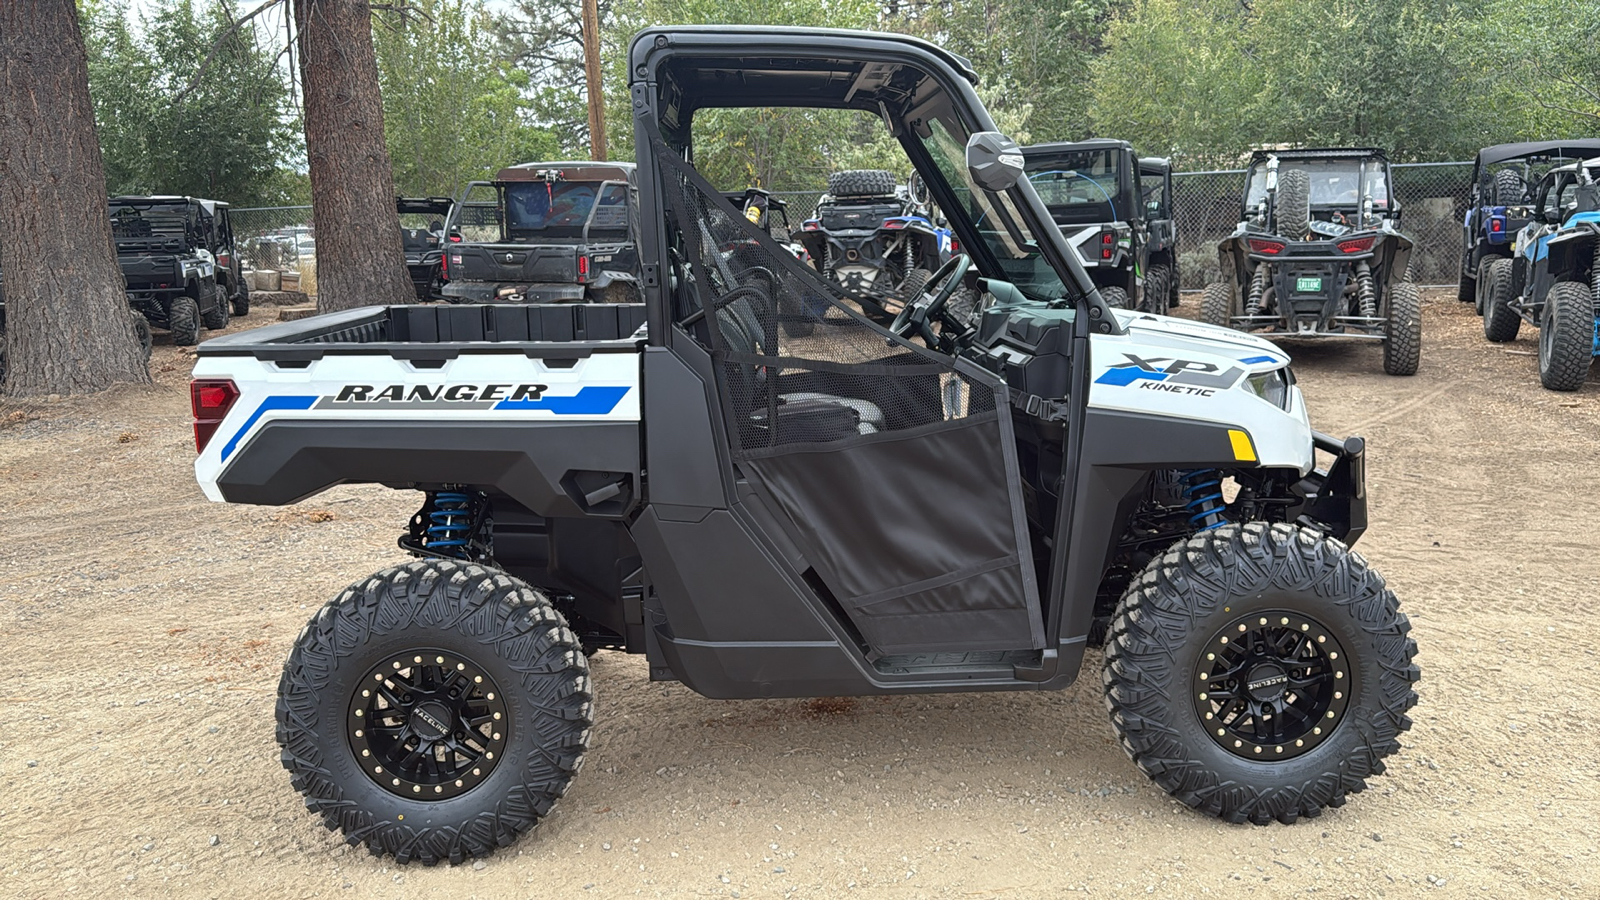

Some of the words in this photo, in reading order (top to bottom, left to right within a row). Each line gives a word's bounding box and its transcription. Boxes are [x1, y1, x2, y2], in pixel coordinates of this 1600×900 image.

[1105, 352, 1219, 374] XP
[335, 384, 549, 401] RANGER
[1139, 381, 1216, 397] KINETIC
[1247, 676, 1288, 691] RACELINE
[413, 707, 449, 735] RACELINE
